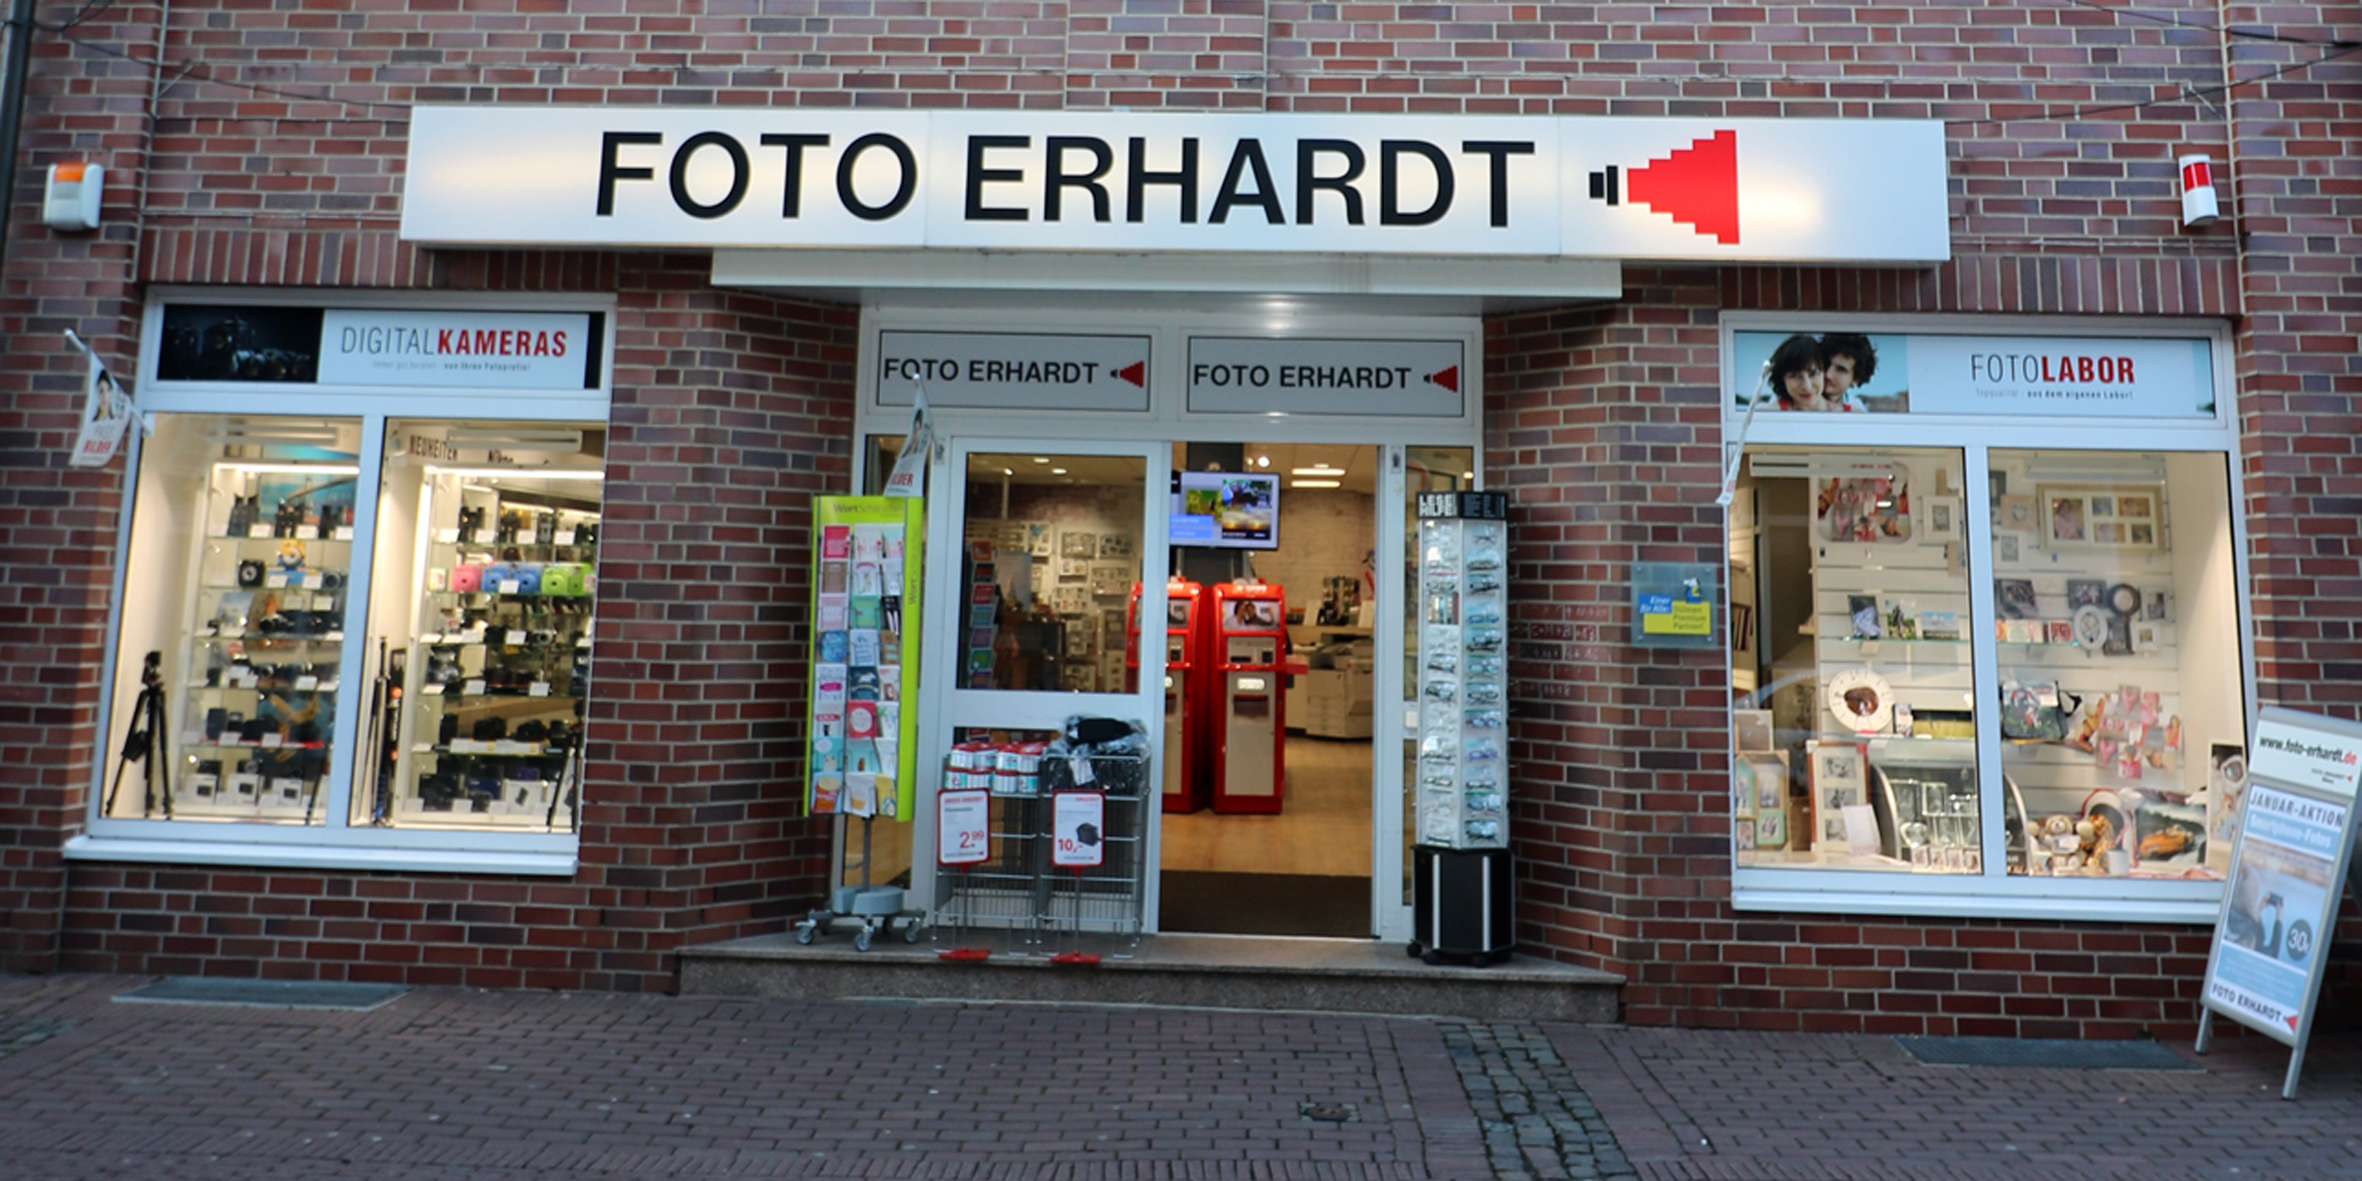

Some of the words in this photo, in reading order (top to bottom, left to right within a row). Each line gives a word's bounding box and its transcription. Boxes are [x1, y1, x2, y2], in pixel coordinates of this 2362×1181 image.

[596, 130, 918, 220] FOTO
[964, 134, 1535, 228] ERHARDT
[341, 326, 568, 358] DIGITALKAMERAS
[883, 357, 960, 382] FOTO
[968, 359, 1099, 384] ERHARDT
[1193, 363, 1270, 387] FOTO
[1279, 364, 1412, 389] ERHARDT
[1971, 353, 2135, 384] FOTOLABOR
[2260, 736, 2358, 765] www.foto-erhardt.de
[2251, 791, 2344, 827] JANUAR-AKTION
[2212, 982, 2236, 1003] FOTO
[2237, 993, 2282, 1023] ERHARDT
